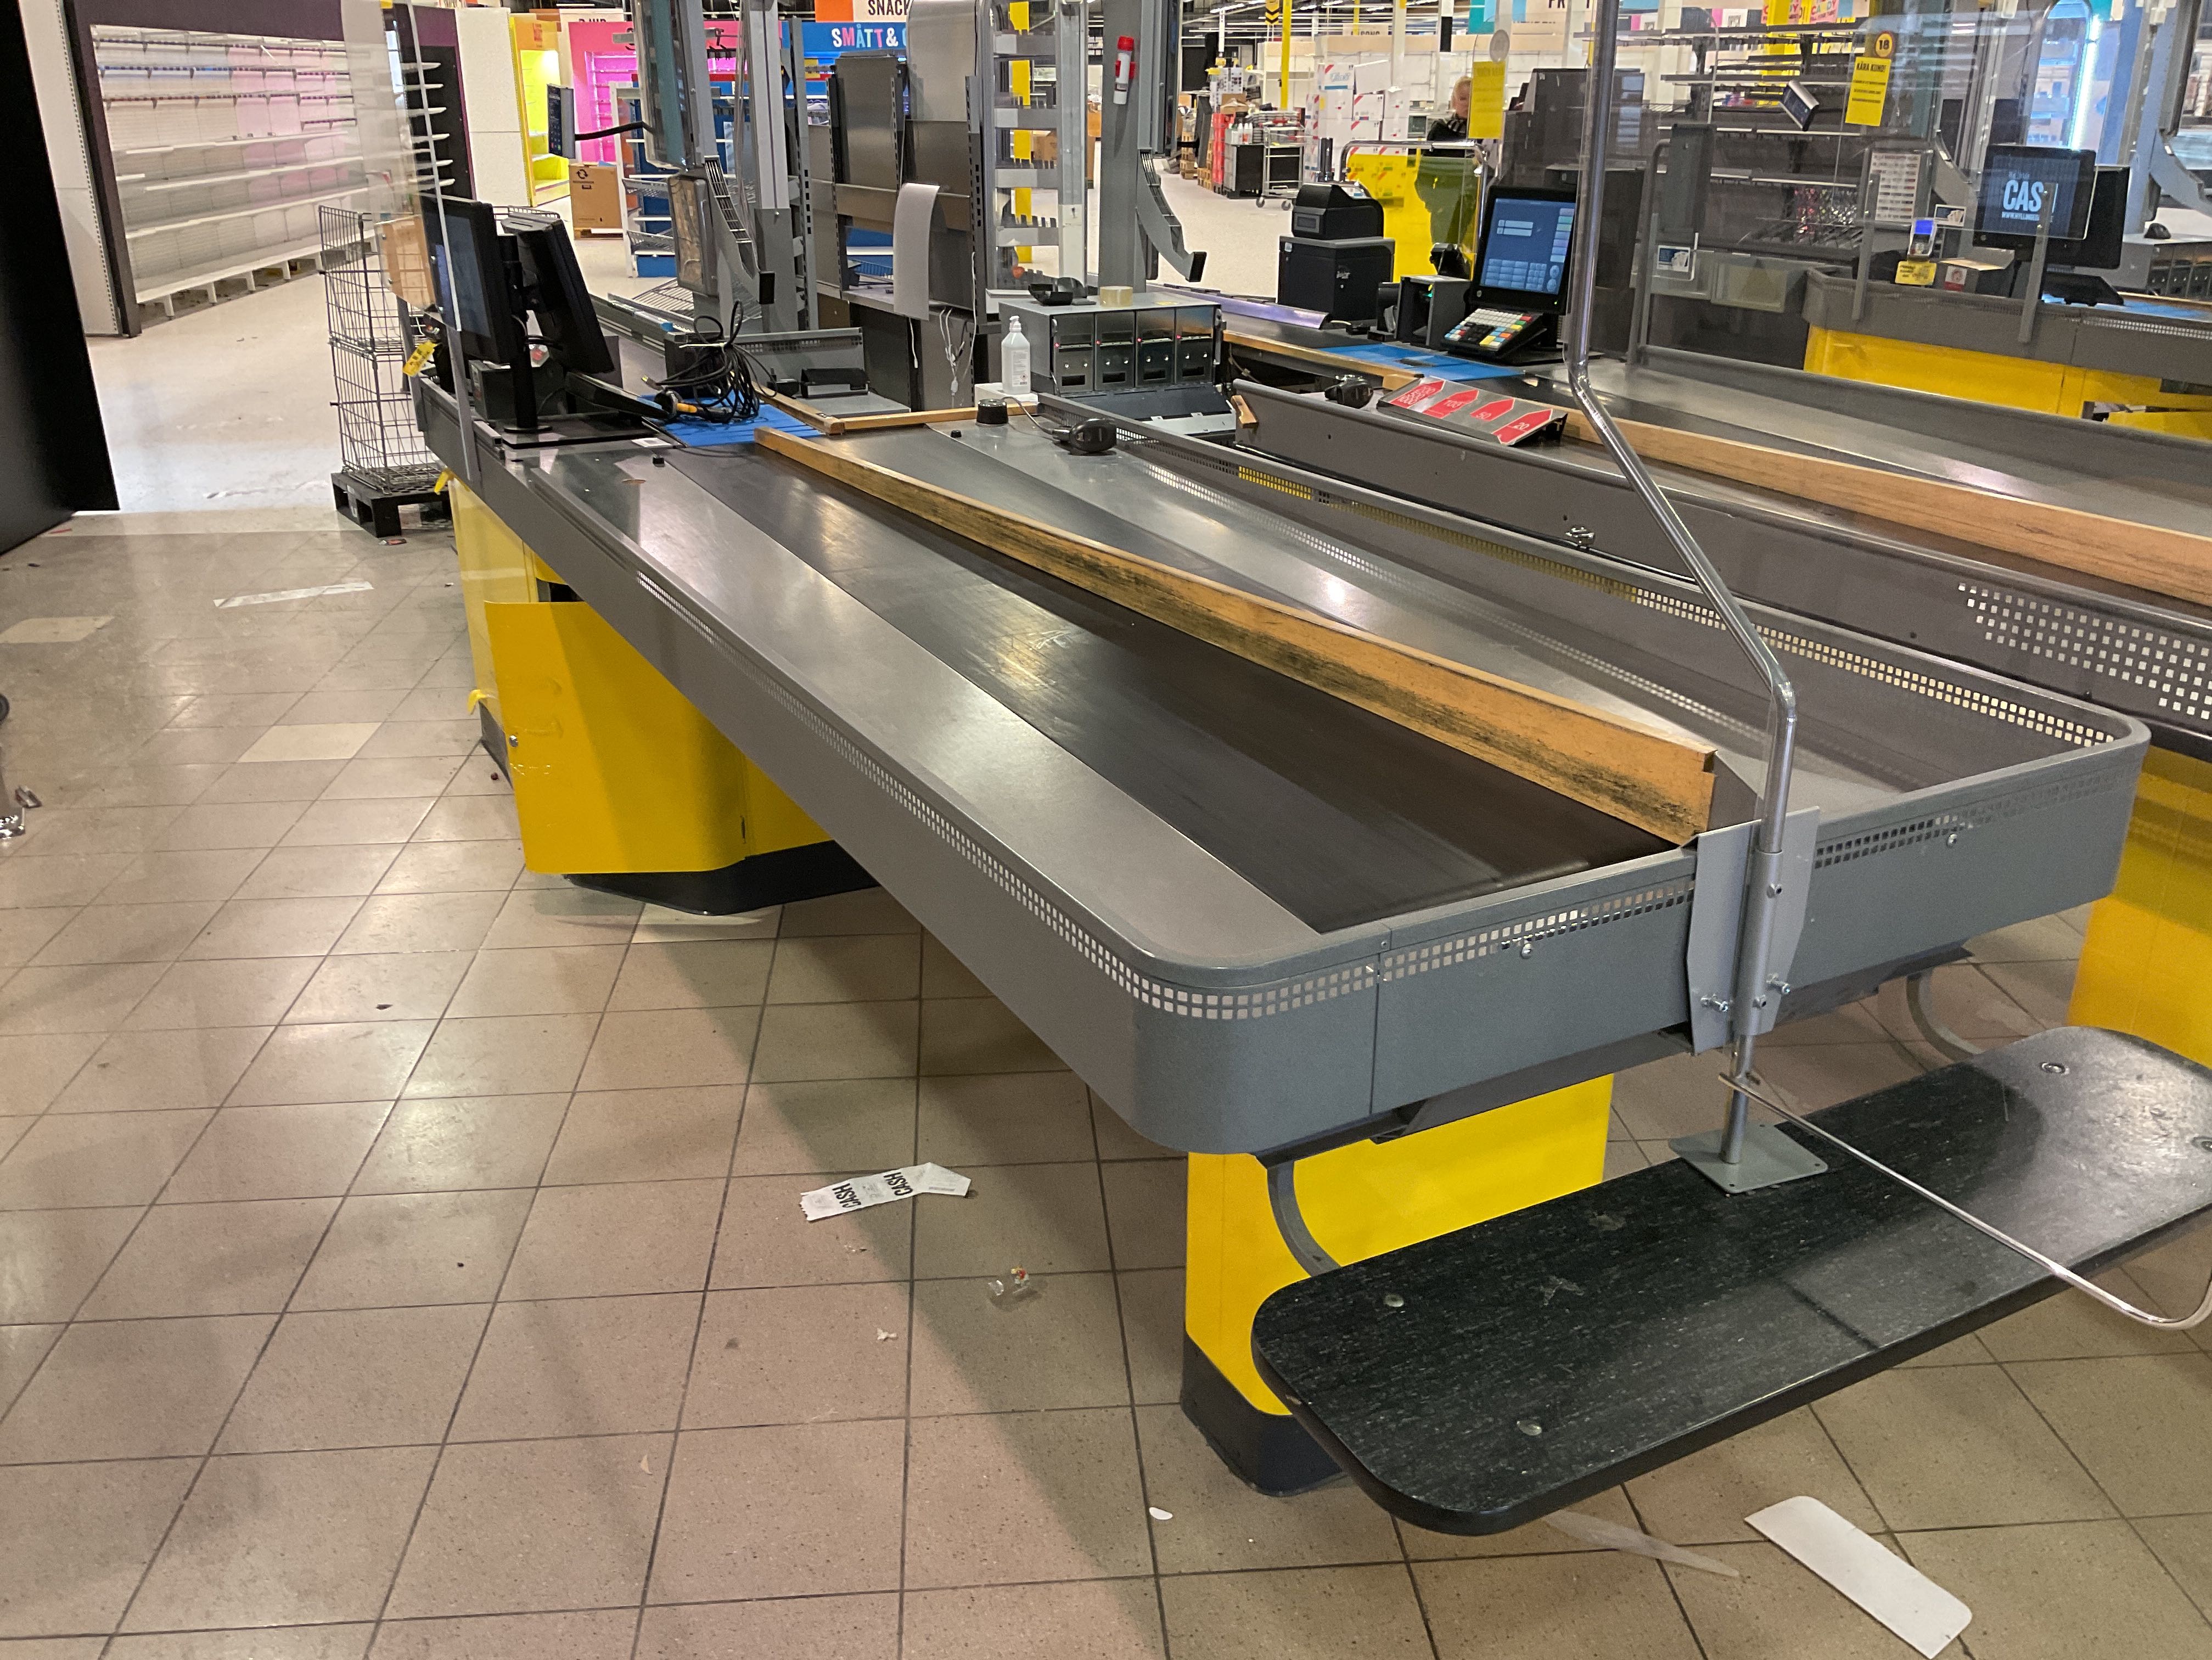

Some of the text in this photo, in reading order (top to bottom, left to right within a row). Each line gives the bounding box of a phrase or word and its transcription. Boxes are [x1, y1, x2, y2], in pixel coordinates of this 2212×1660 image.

[831, 24, 883, 48] SMÅTT
[886, 27, 899, 47] &
[1879, 40, 1890, 50] 18
[1856, 61, 1869, 71] KÄRA
[832, 1182, 862, 1209] CASH
[883, 1171, 913, 1197] CASH
